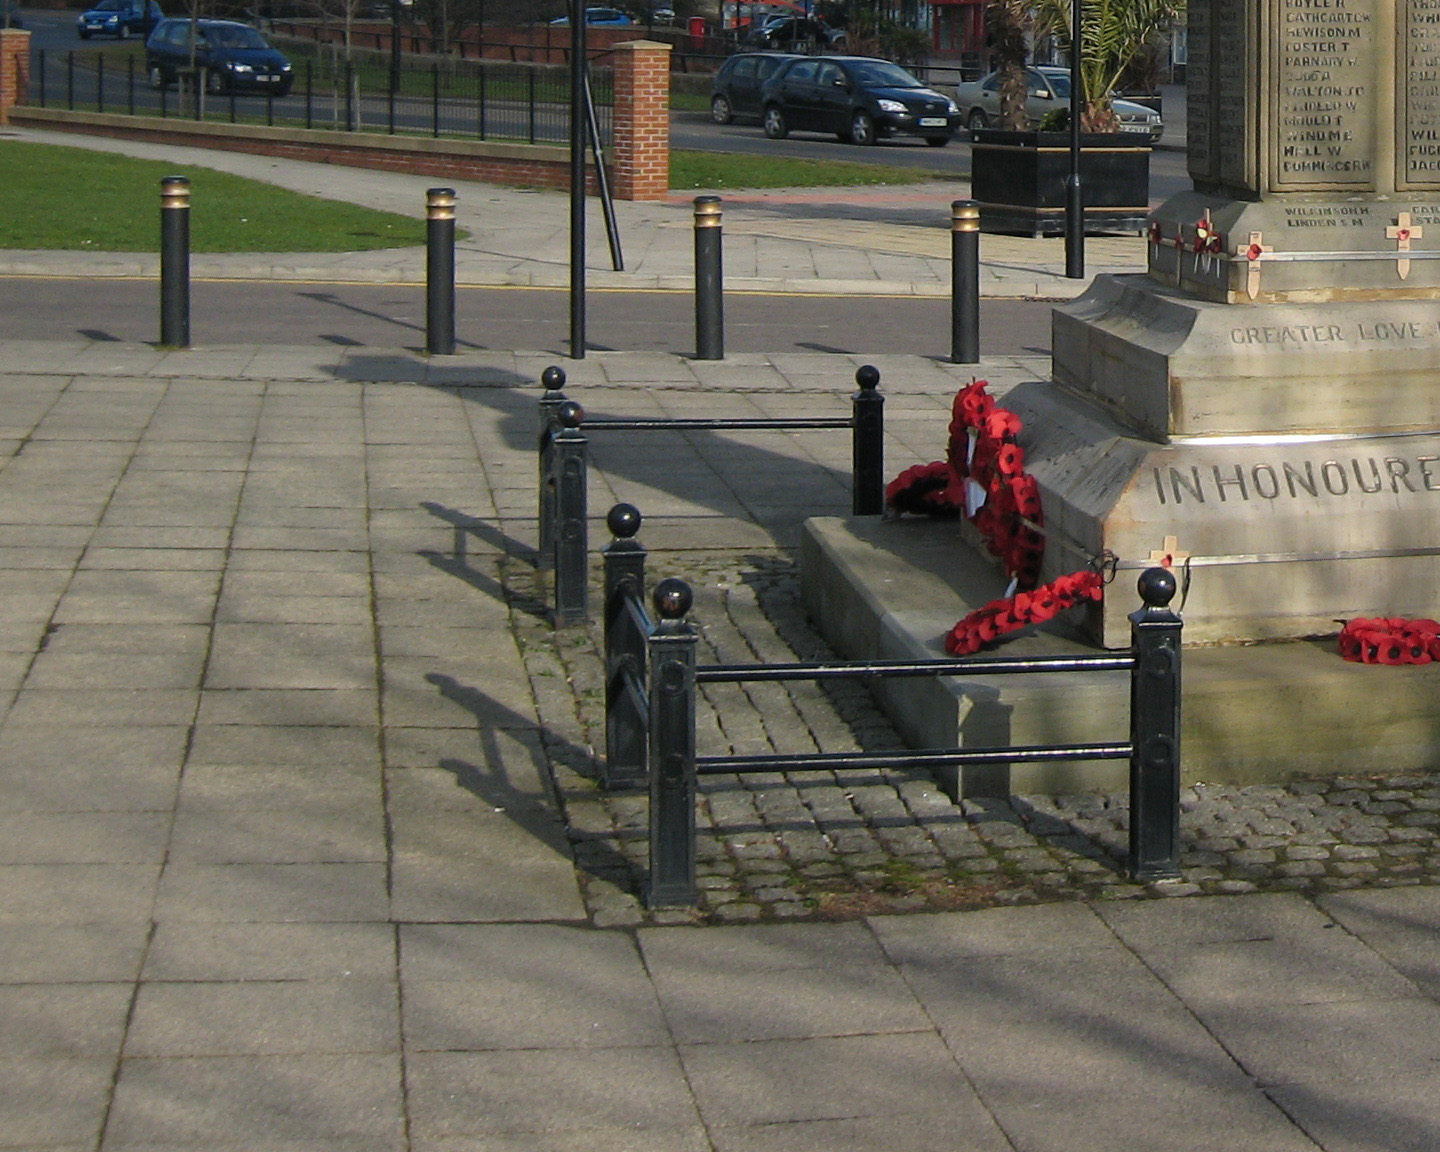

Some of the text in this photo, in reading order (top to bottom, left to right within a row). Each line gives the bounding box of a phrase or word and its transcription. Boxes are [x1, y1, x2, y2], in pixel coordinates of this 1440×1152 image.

[1285, 12, 1353, 24] CATHCART
[1284, 41, 1351, 53] FOSTER T
[1287, 218, 1338, 228] LINDEN
[1231, 325, 1344, 345] GREATER
[1360, 321, 1421, 341] LOVE
[1152, 465, 1205, 505] IN
